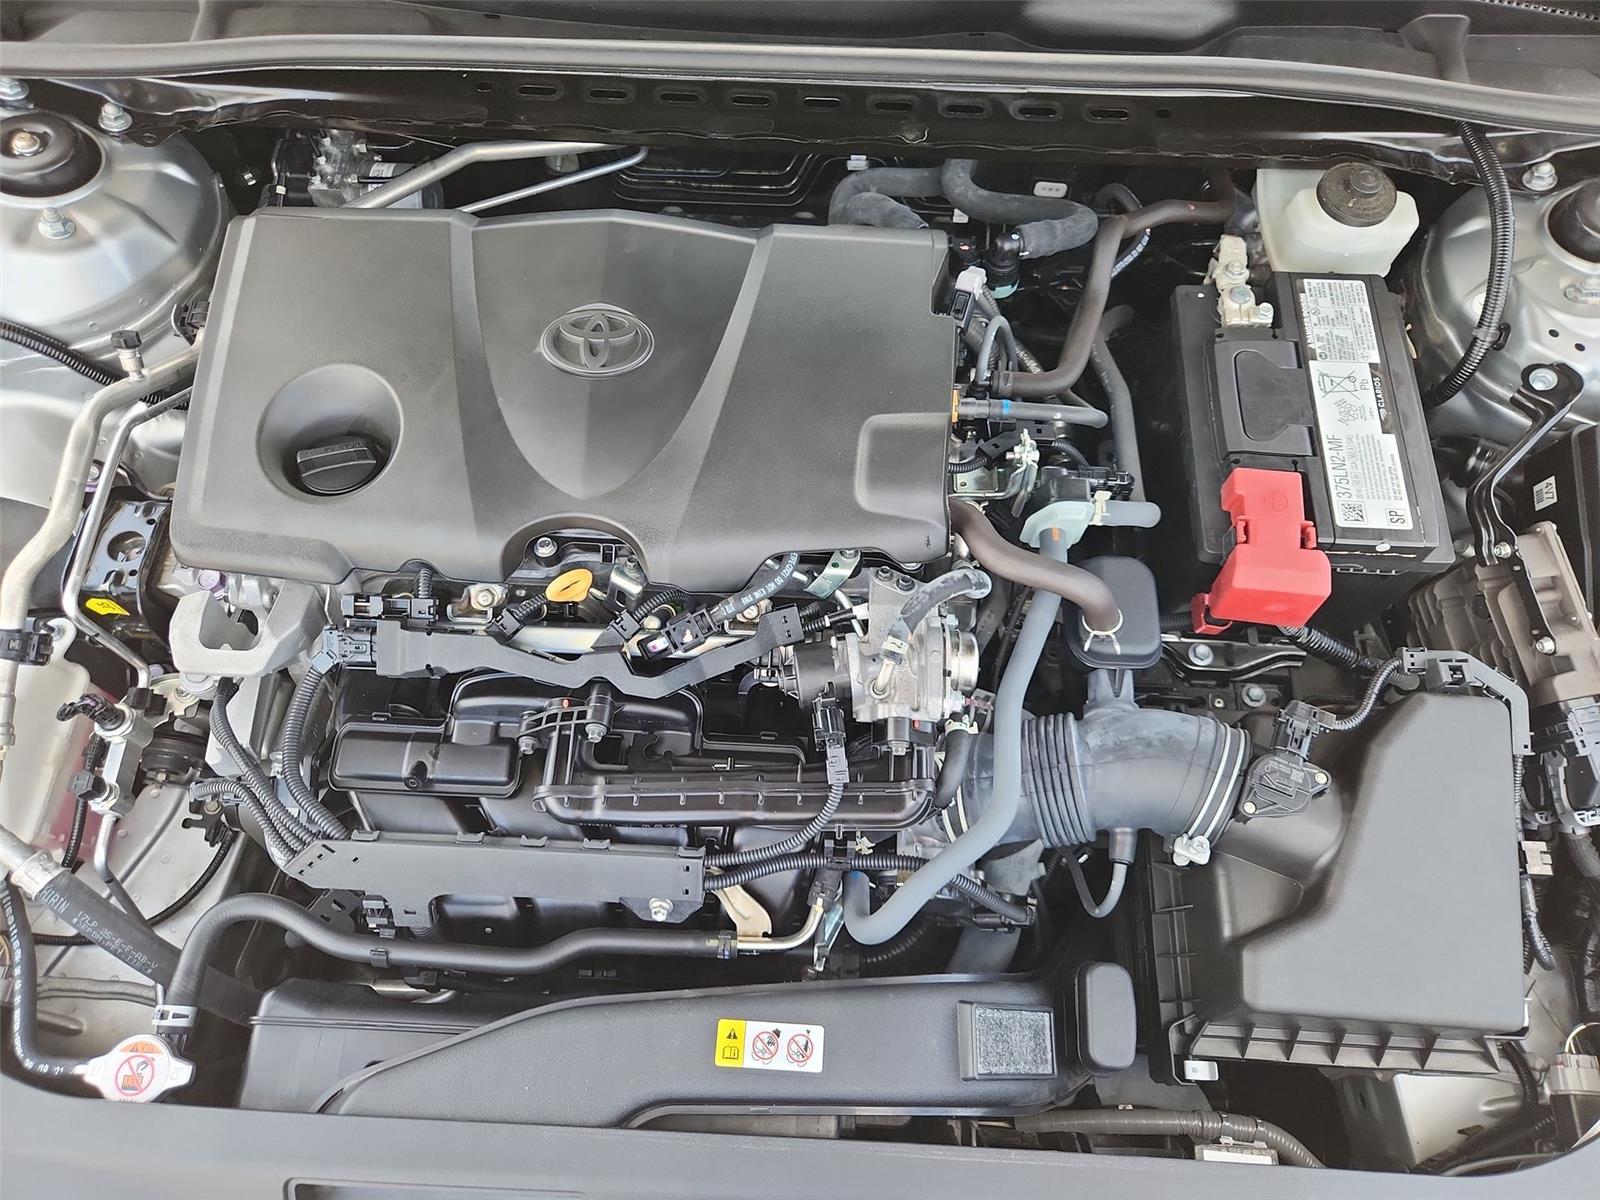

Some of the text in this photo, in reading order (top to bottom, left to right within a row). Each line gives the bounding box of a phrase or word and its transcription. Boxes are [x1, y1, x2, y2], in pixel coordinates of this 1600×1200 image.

[1373, 377, 1385, 408] CLARIOS
[1326, 434, 1352, 499] 375LN2-MF
[1388, 510, 1406, 524] SP
